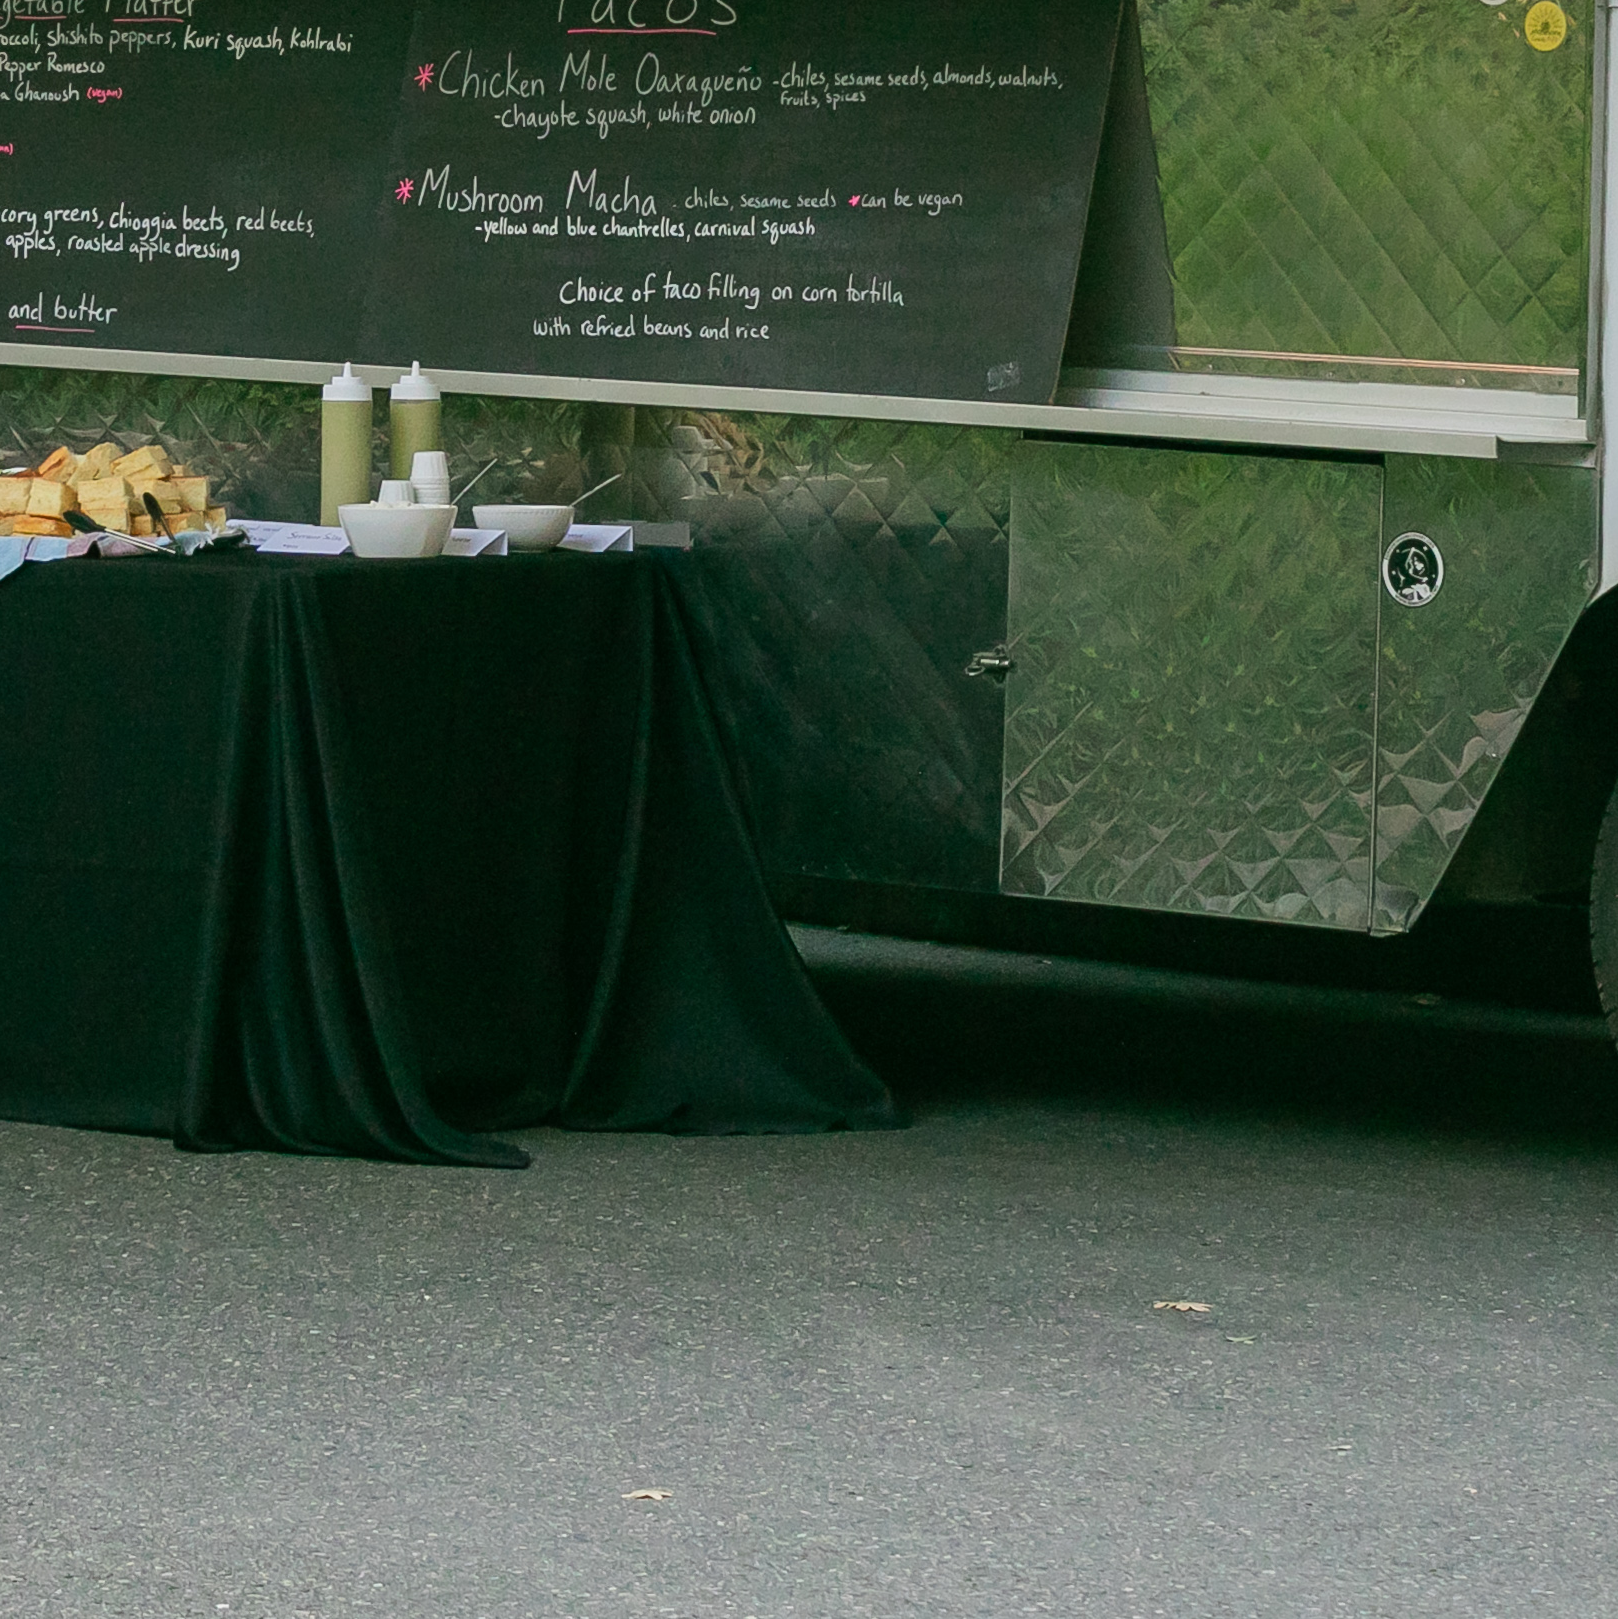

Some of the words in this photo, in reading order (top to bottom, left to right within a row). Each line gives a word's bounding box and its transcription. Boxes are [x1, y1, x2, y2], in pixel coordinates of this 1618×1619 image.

[47, 22, 103, 47] shishito
[109, 29, 177, 54] peppers,
[226, 26, 285, 60] squash,
[289, 26, 354, 53] Kohlrabi
[46, 51, 106, 74] Romesco
[438, 48, 545, 99] Chicken
[559, 50, 617, 93] Mole
[635, 52, 762, 107] Oaxaqueño
[834, 72, 884, 87] sesame
[888, 65, 929, 90] seeds,
[932, 63, 996, 88] almonds,
[998, 64, 1064, 90] walnuts,
[14, 80, 80, 102] Ghanoush
[86, 86, 123, 104] (vegan)
[825, 89, 867, 111] spices
[585, 101, 651, 140] squash,
[658, 101, 703, 124] white
[709, 105, 756, 125] onion
[418, 164, 544, 214] Mushroom
[565, 167, 658, 217] Macha
[684, 186, 734, 212] chiles,
[739, 193, 792, 210] sesame
[796, 186, 837, 208] seeds
[861, 194, 887, 208] can
[893, 186, 914, 208] be
[918, 192, 964, 216] vegan
[43, 206, 105, 235] greens,
[109, 201, 177, 241] chioggia
[182, 204, 228, 239] beets,
[235, 206, 265, 232] red
[270, 208, 315, 239] beets,
[532, 216, 559, 237] and
[566, 216, 598, 238] blue
[602, 215, 691, 242] chantrelles,
[693, 215, 756, 237] carnival
[761, 215, 816, 246] squash
[5, 230, 62, 259] apples,
[67, 232, 124, 254] roasted
[129, 237, 172, 263] apple
[174, 233, 240, 271] dressing
[8, 292, 43, 323] and
[54, 292, 118, 324] butter
[559, 281, 624, 305] Choice
[630, 272, 657, 303] of
[662, 270, 702, 300] taco
[707, 271, 761, 310] filling
[771, 284, 793, 301] on
[801, 285, 838, 303] corn
[845, 272, 905, 307] tortilla
[532, 315, 572, 337] with
[579, 314, 637, 338] refried
[643, 314, 693, 340] beans
[698, 316, 730, 340] and
[734, 323, 771, 340] rice
